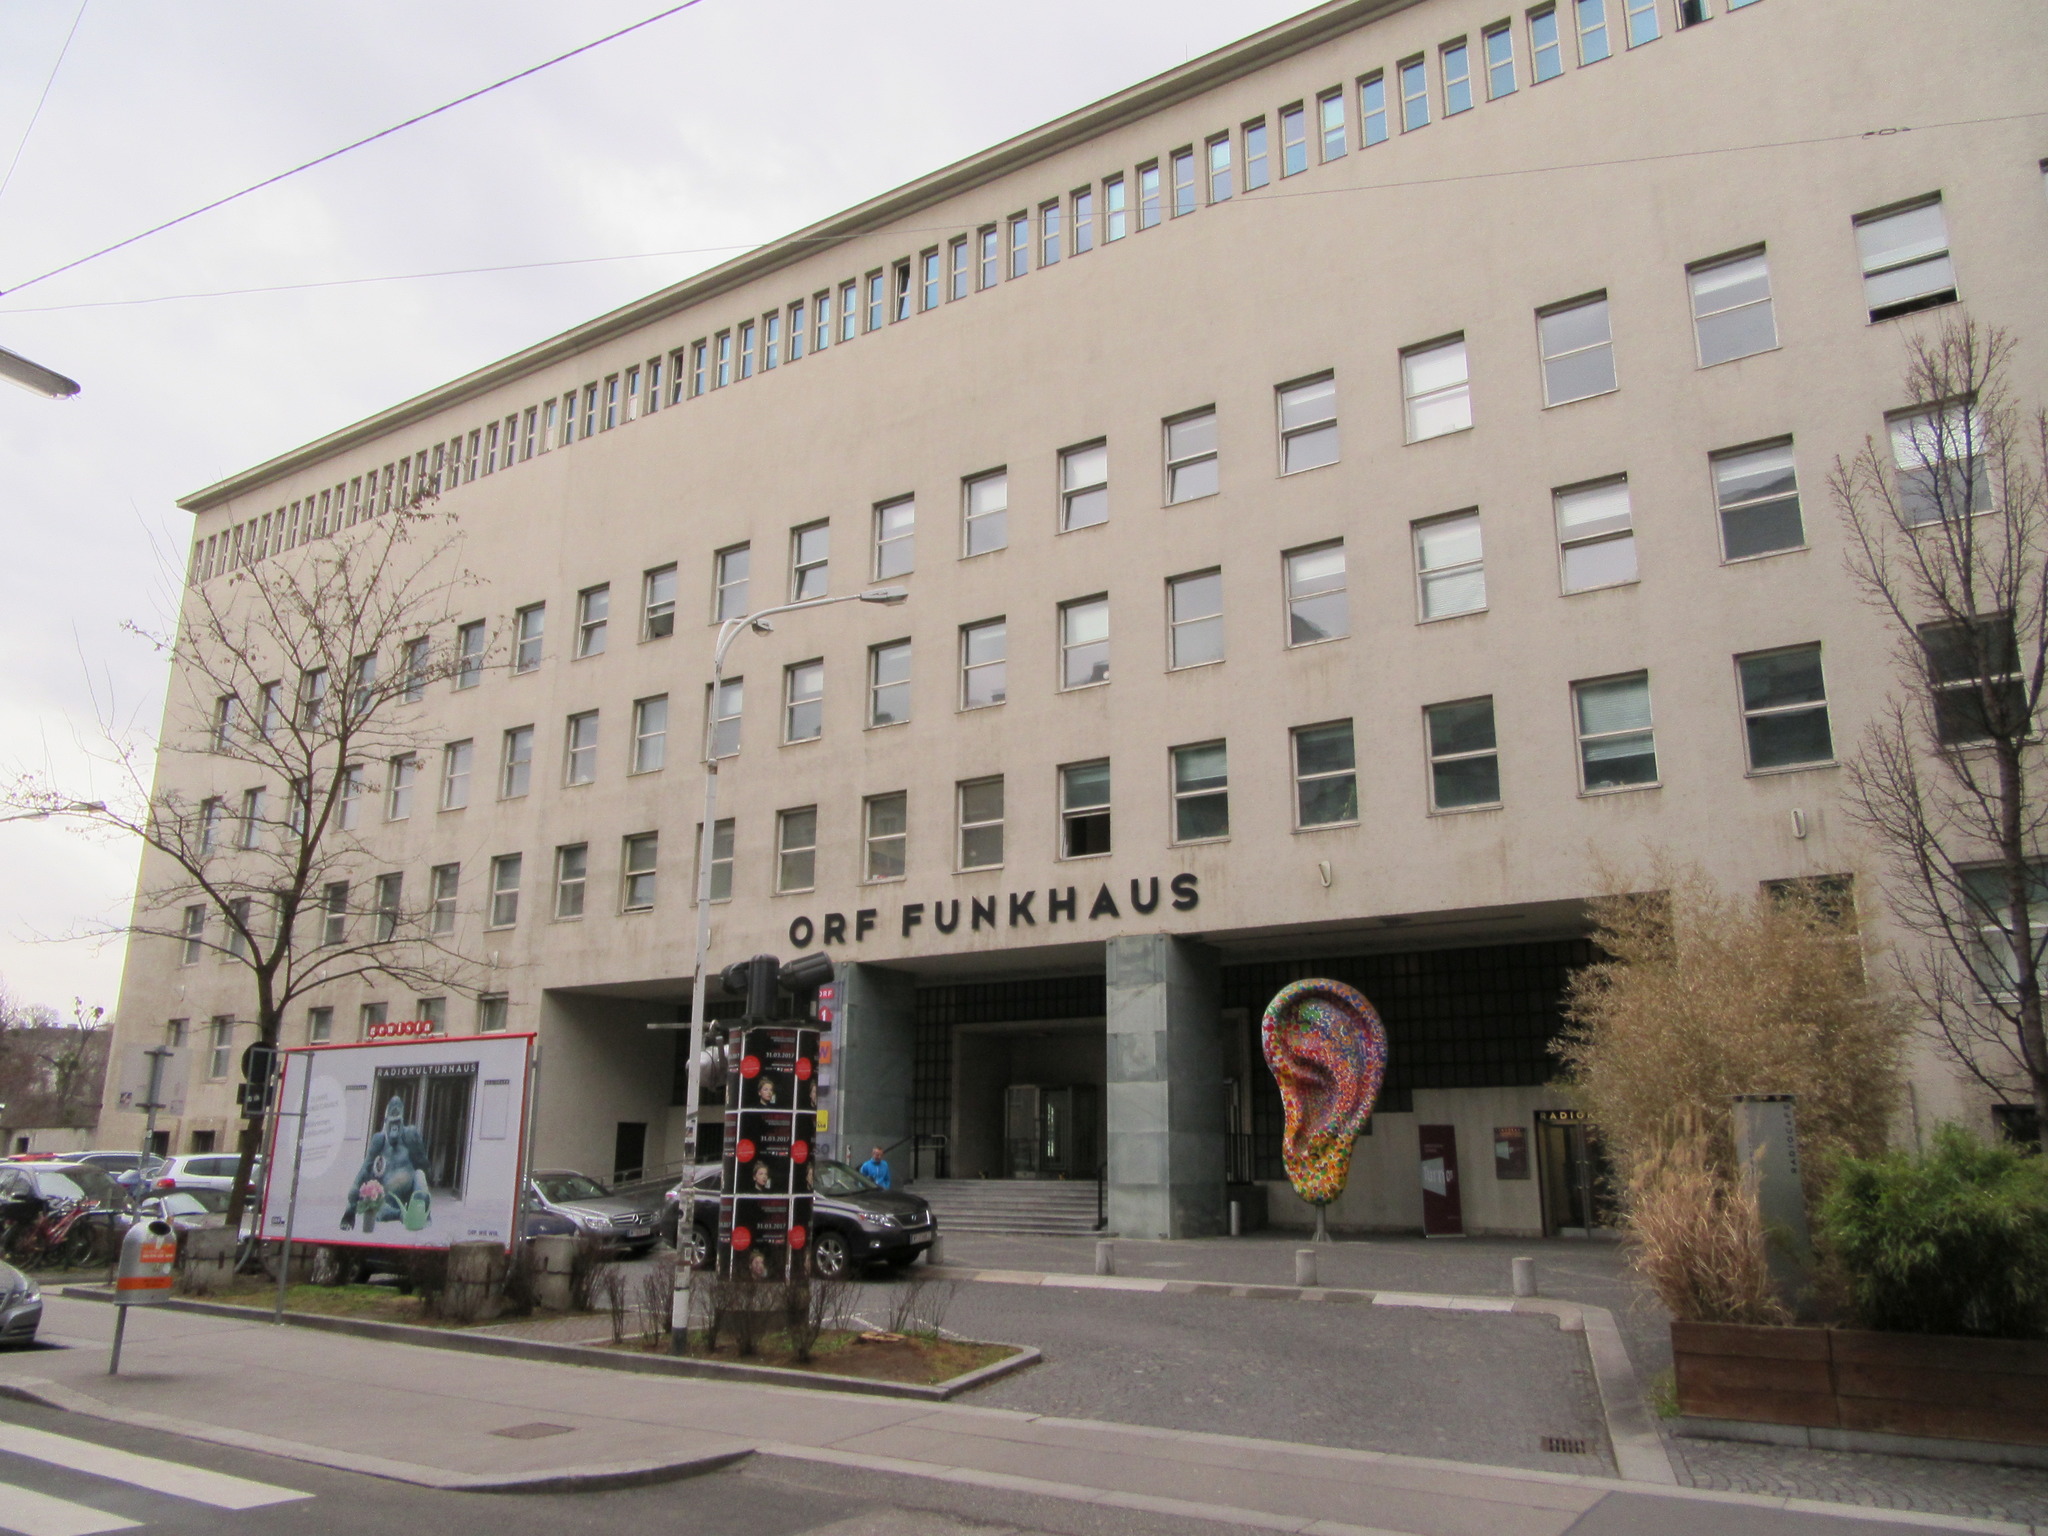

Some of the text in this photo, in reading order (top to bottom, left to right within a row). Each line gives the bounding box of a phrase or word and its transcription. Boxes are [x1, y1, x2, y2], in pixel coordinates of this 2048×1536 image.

[789, 873, 1200, 949] ORF FUNKHAUS
[377, 1063, 476, 1077] RADIOKULTURHAUS
